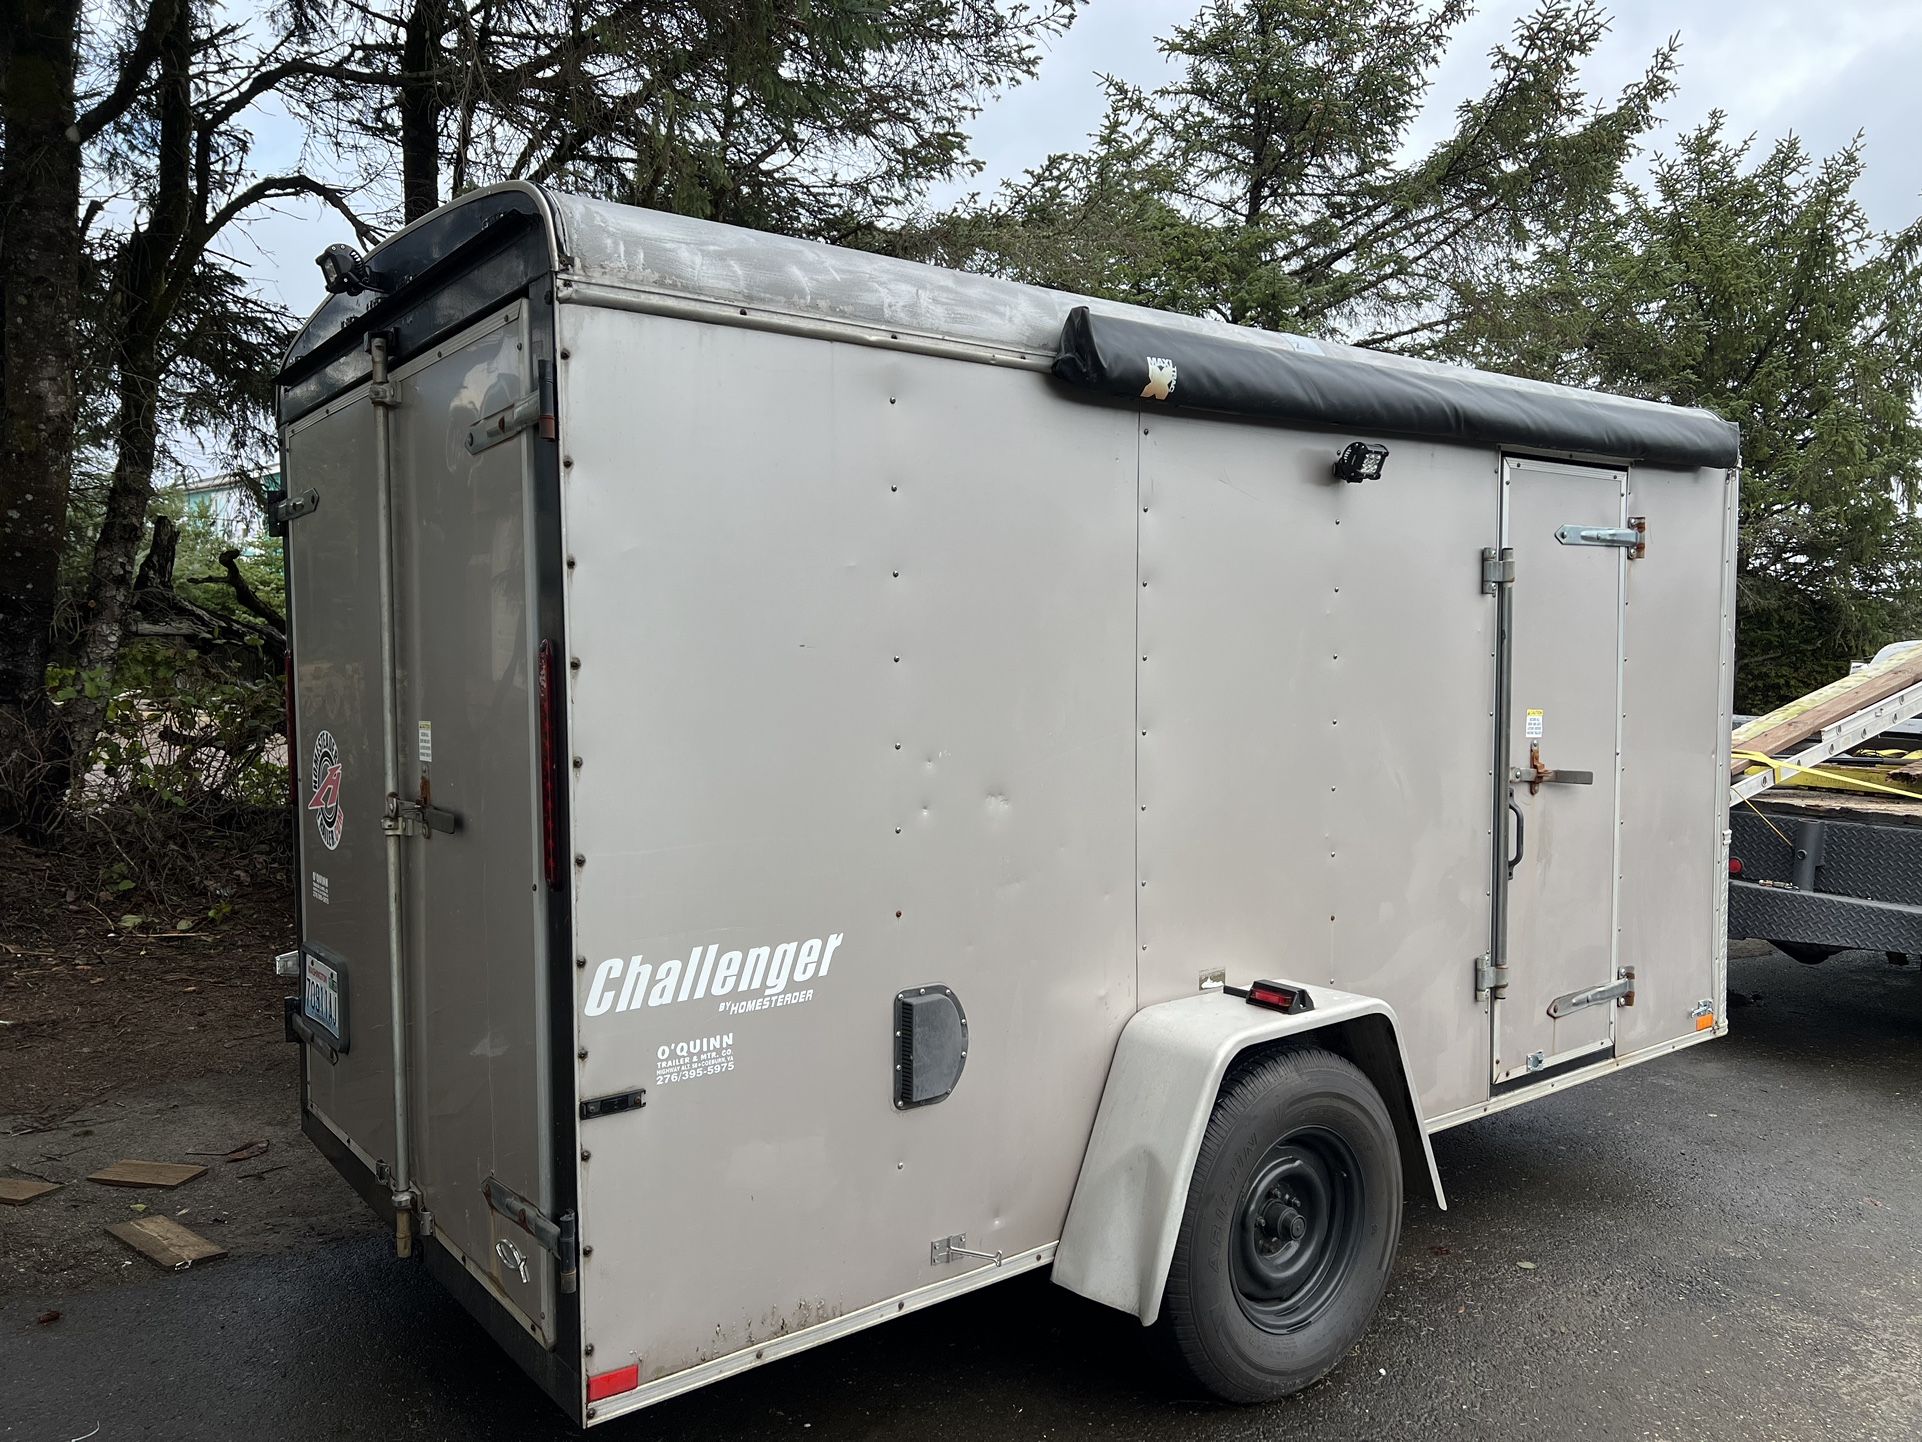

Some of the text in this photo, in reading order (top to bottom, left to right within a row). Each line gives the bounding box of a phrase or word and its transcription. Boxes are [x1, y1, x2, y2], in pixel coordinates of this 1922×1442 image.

[584, 932, 844, 1017] Challenger
[719, 989, 814, 1015] BY HOMESTEADER
[657, 1032, 734, 1060] O'QUINN
[656, 1056, 690, 1069] TRAILER
[700, 1051, 719, 1061] MTR.
[656, 1061, 735, 1086] 276/395-5975
